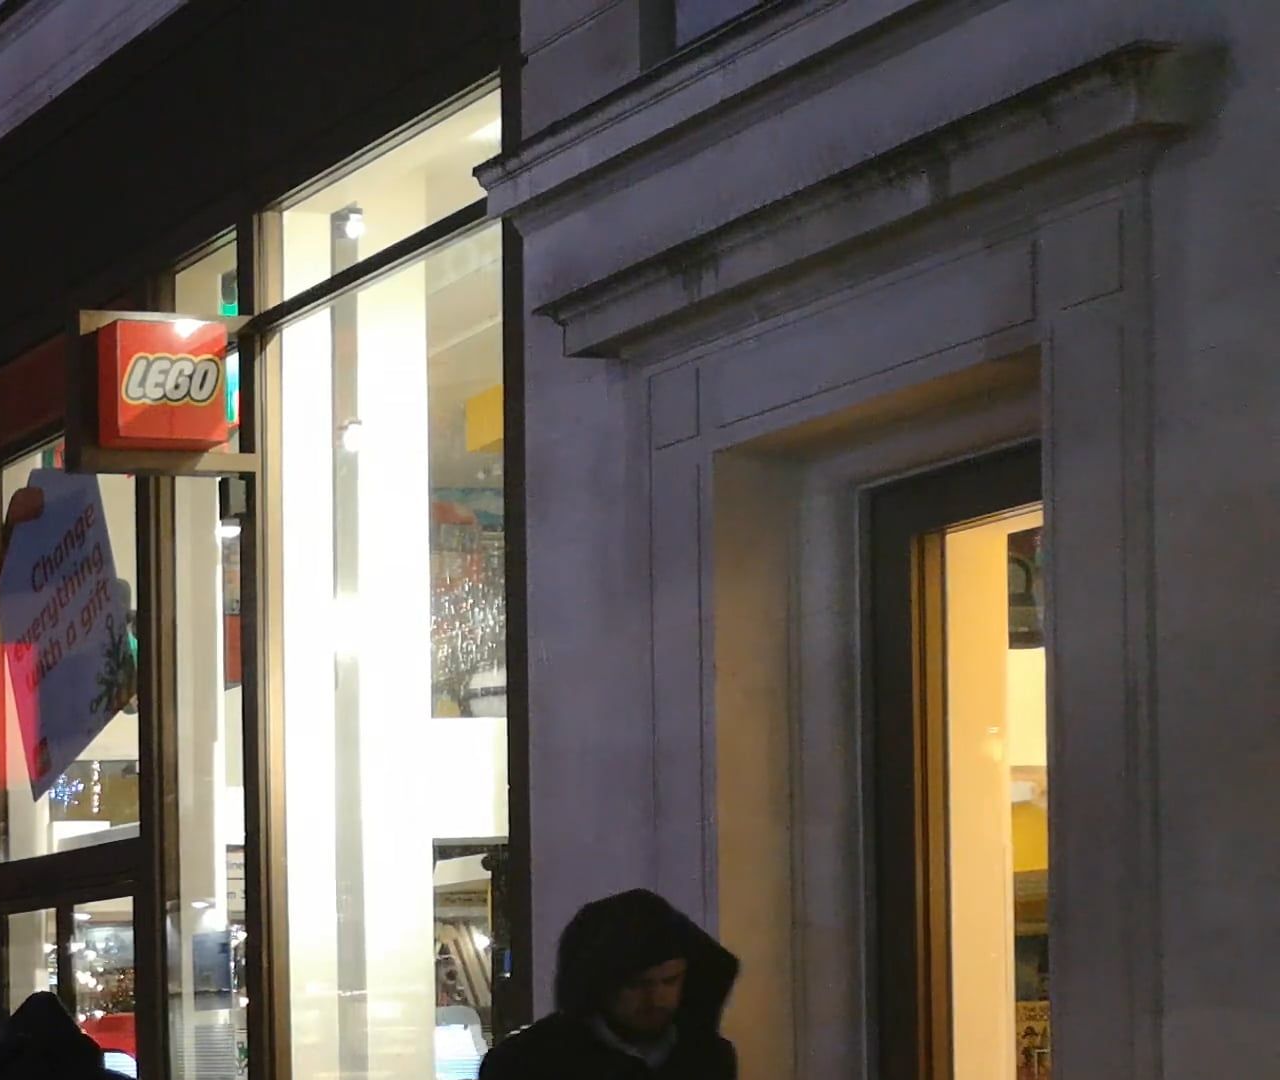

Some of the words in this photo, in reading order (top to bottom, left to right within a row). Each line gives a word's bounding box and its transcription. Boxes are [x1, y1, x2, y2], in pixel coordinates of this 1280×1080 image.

[123, 353, 220, 404] LEGO
[31, 503, 95, 593] Change
[14, 542, 104, 662] everything
[26, 637, 63, 694] with
[65, 620, 77, 651] a
[80, 577, 112, 635] gift
